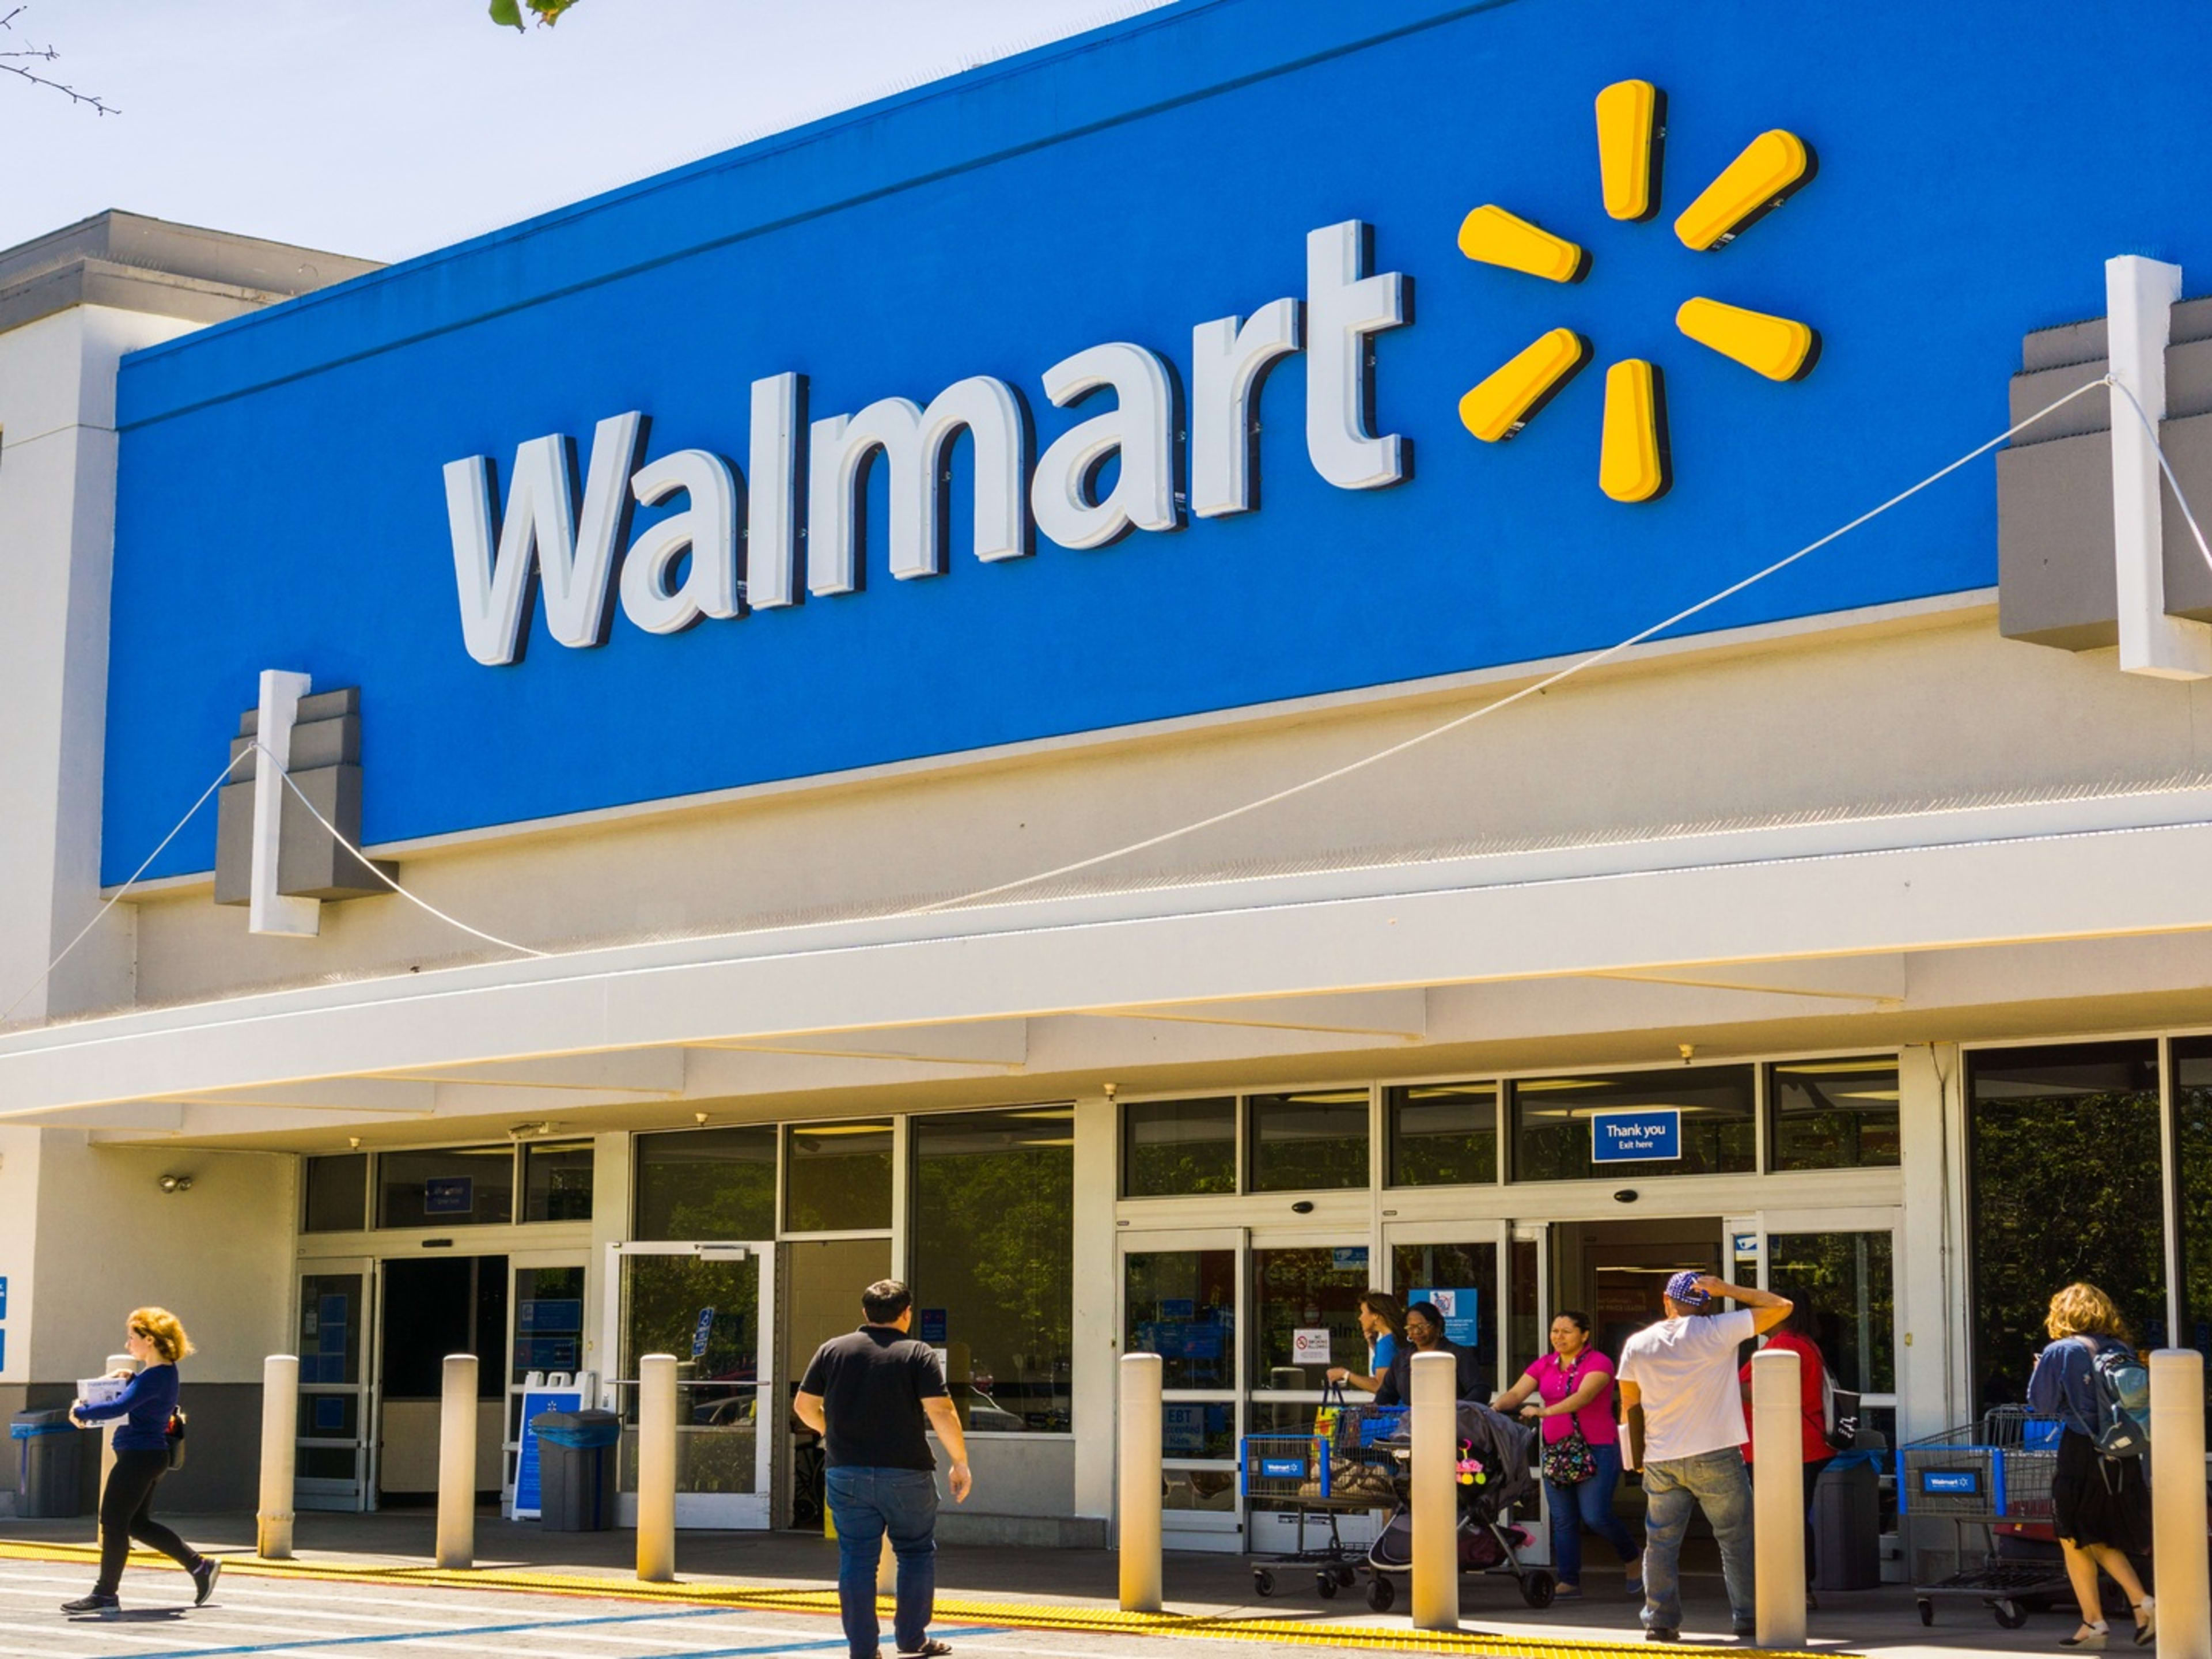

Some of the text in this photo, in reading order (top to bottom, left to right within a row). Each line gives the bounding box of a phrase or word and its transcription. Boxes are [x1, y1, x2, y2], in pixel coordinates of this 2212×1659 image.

[443, 219, 1412, 666] Walmart
[1606, 1123, 1666, 1139] Thank you
[1618, 1139, 1653, 1150] Exit here
[1168, 1409, 1192, 1423] EBT
[1165, 1423, 1200, 1435] ccepted
